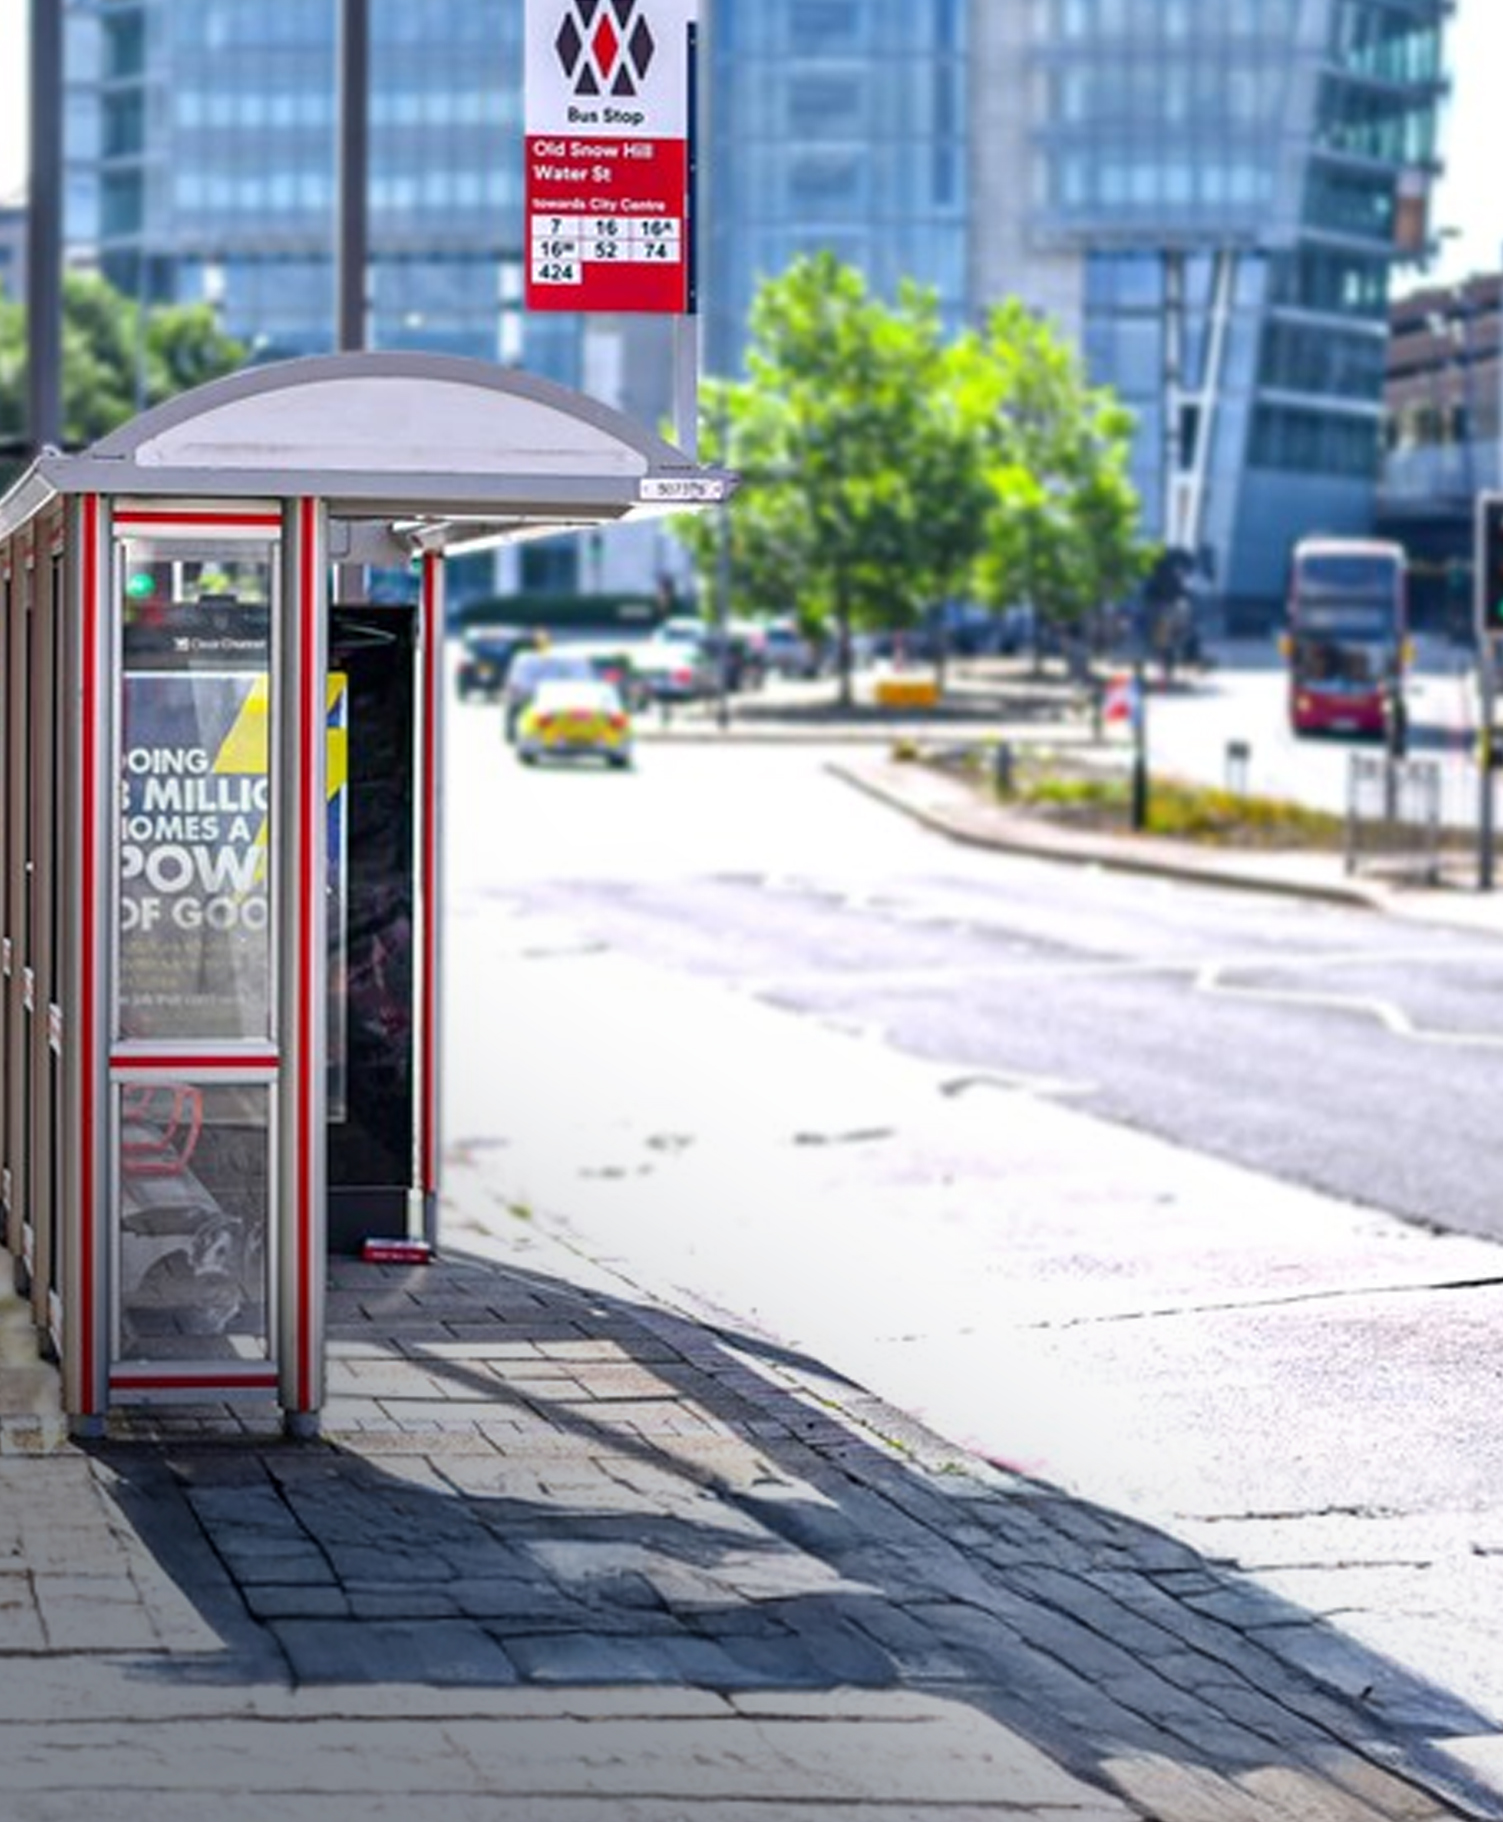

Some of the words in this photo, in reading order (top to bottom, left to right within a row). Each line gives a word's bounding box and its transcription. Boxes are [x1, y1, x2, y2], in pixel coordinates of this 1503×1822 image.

[567, 106, 598, 123] Bus
[603, 107, 645, 126] Stop
[532, 139, 566, 157] Old
[569, 141, 619, 158] Snow
[622, 142, 655, 160] Hill
[532, 164, 588, 181] Water
[591, 165, 613, 183] St
[588, 198, 618, 213] City
[620, 198, 666, 213] Centre
[550, 217, 562, 234] 7
[596, 219, 619, 237] 16
[595, 241, 618, 259] 52
[645, 242, 667, 259] 74
[538, 263, 574, 281] 424
[122, 748, 210, 775] OING
[228, 815, 251, 841] A
[122, 844, 268, 893] POW
[172, 897, 268, 931] GOO
